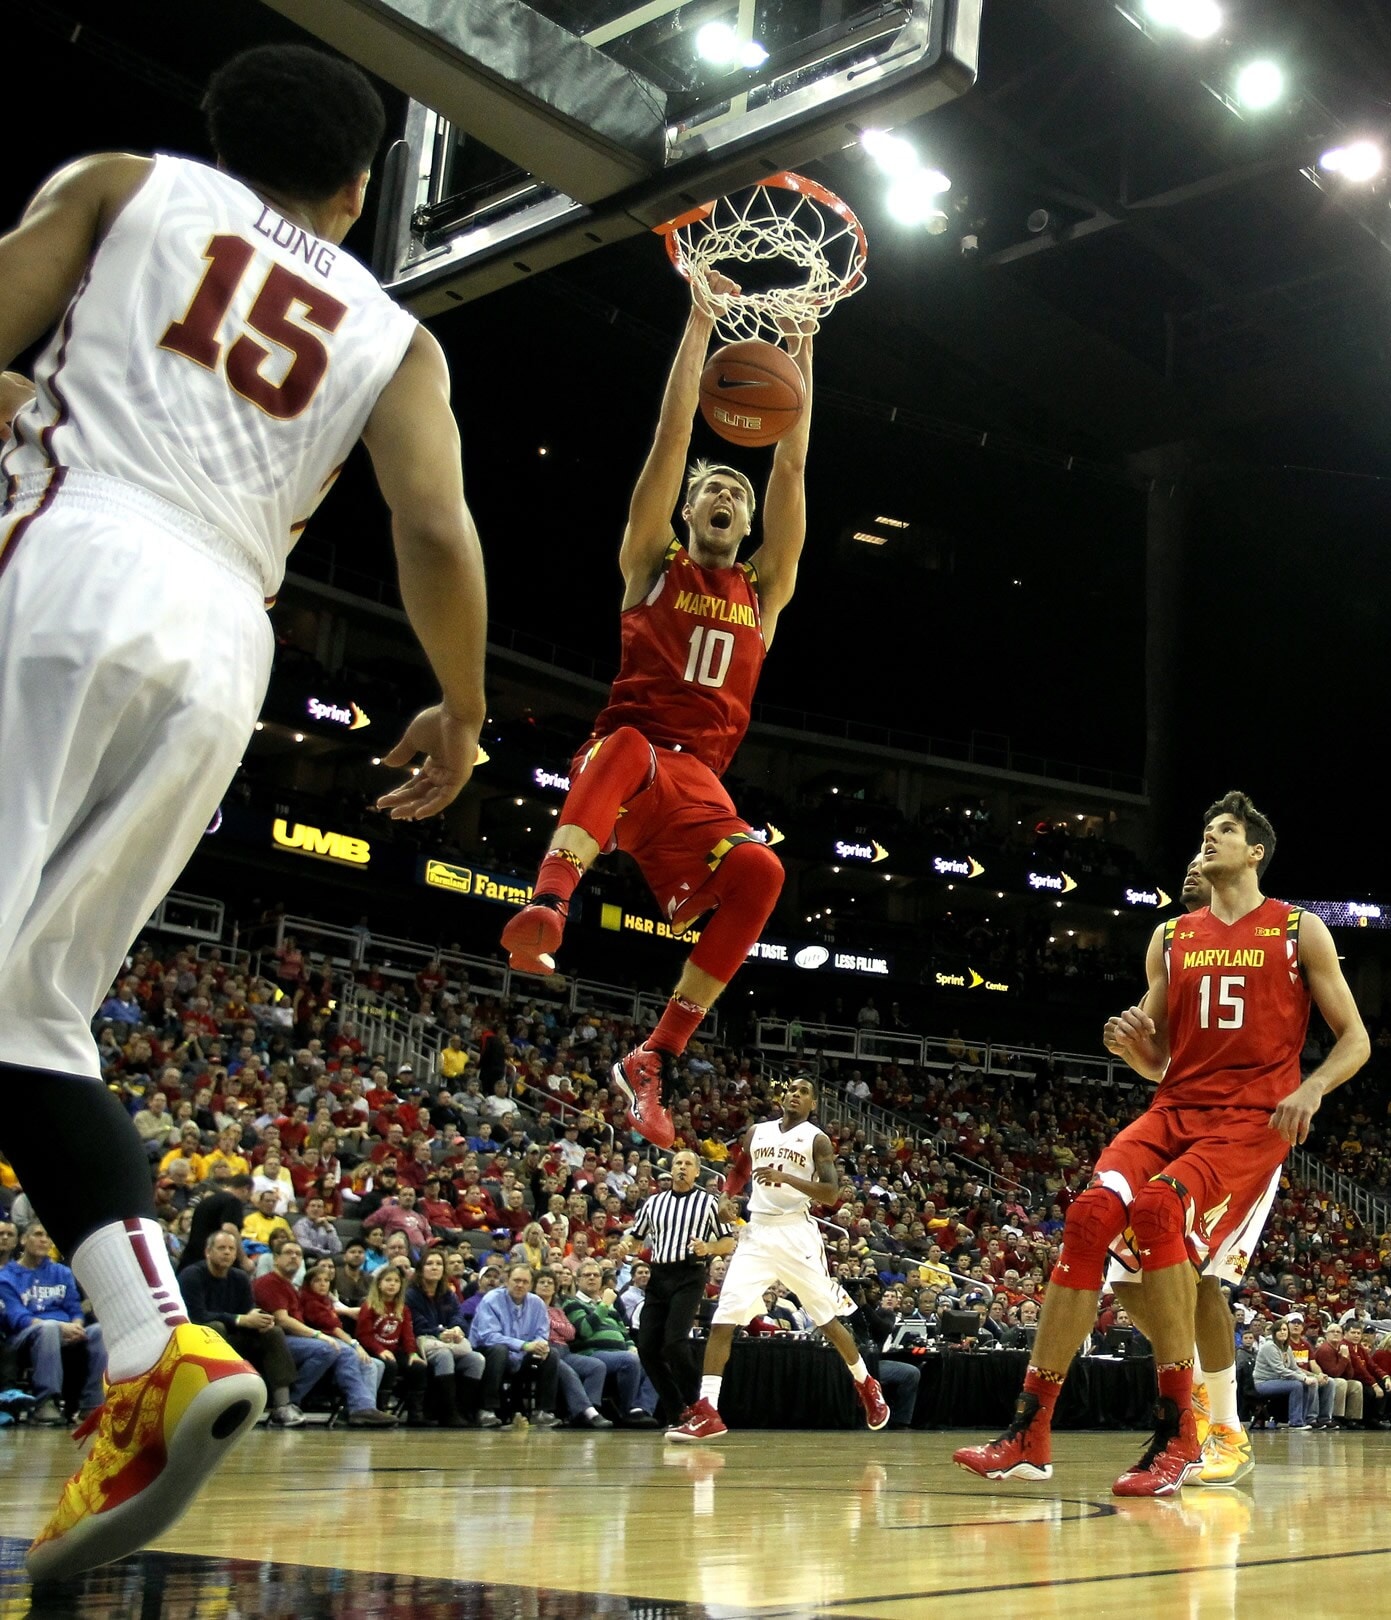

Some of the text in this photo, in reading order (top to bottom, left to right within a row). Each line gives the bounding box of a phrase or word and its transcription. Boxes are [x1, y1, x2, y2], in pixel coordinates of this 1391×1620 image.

[253, 205, 337, 278] LONG
[156, 233, 349, 421] 15
[713, 406, 762, 430] ELITE
[673, 589, 757, 628] MARYLAND
[683, 625, 735, 688] 10
[308, 698, 352, 725] Sprint
[535, 768, 570, 791] Sprint
[272, 818, 371, 864] UMB
[835, 840, 873, 860] Sprint
[934, 855, 969, 875] Sprint
[429, 872, 467, 890] Farmland
[1028, 872, 1062, 890] Sprint
[1125, 888, 1158, 906] Sprint
[624, 913, 654, 934] H&R
[834, 953, 856, 970] LESS
[1183, 949, 1265, 970] MARYLAND
[935, 972, 1009, 992] Sprint Center
[1199, 975, 1246, 1030] 15
[777, 1148, 806, 1168] STATE
